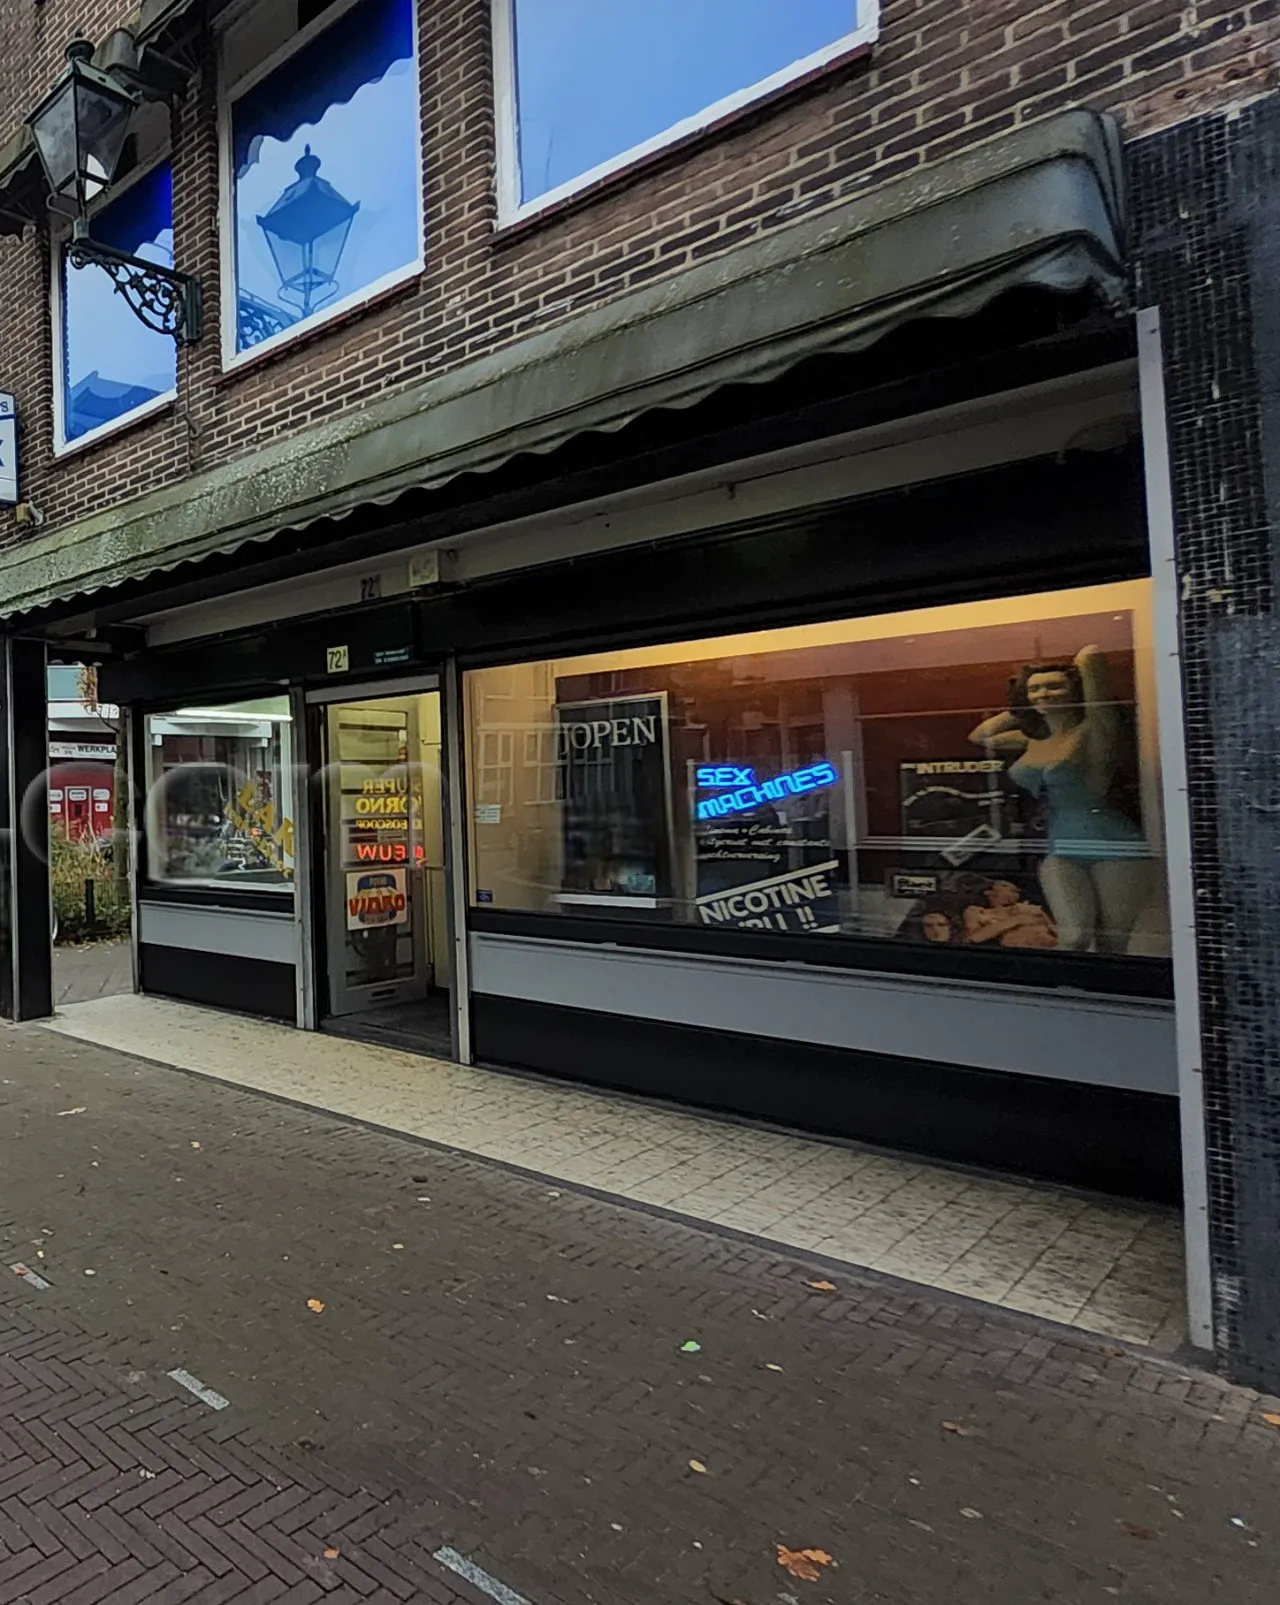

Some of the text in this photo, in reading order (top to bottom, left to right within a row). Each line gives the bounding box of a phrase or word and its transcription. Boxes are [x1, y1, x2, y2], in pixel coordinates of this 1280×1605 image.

[697, 767, 753, 787] SEX
[697, 762, 836, 819] MACHINES
[349, 892, 406, 917] VIDEO
[698, 874, 833, 925] NICOTINE
